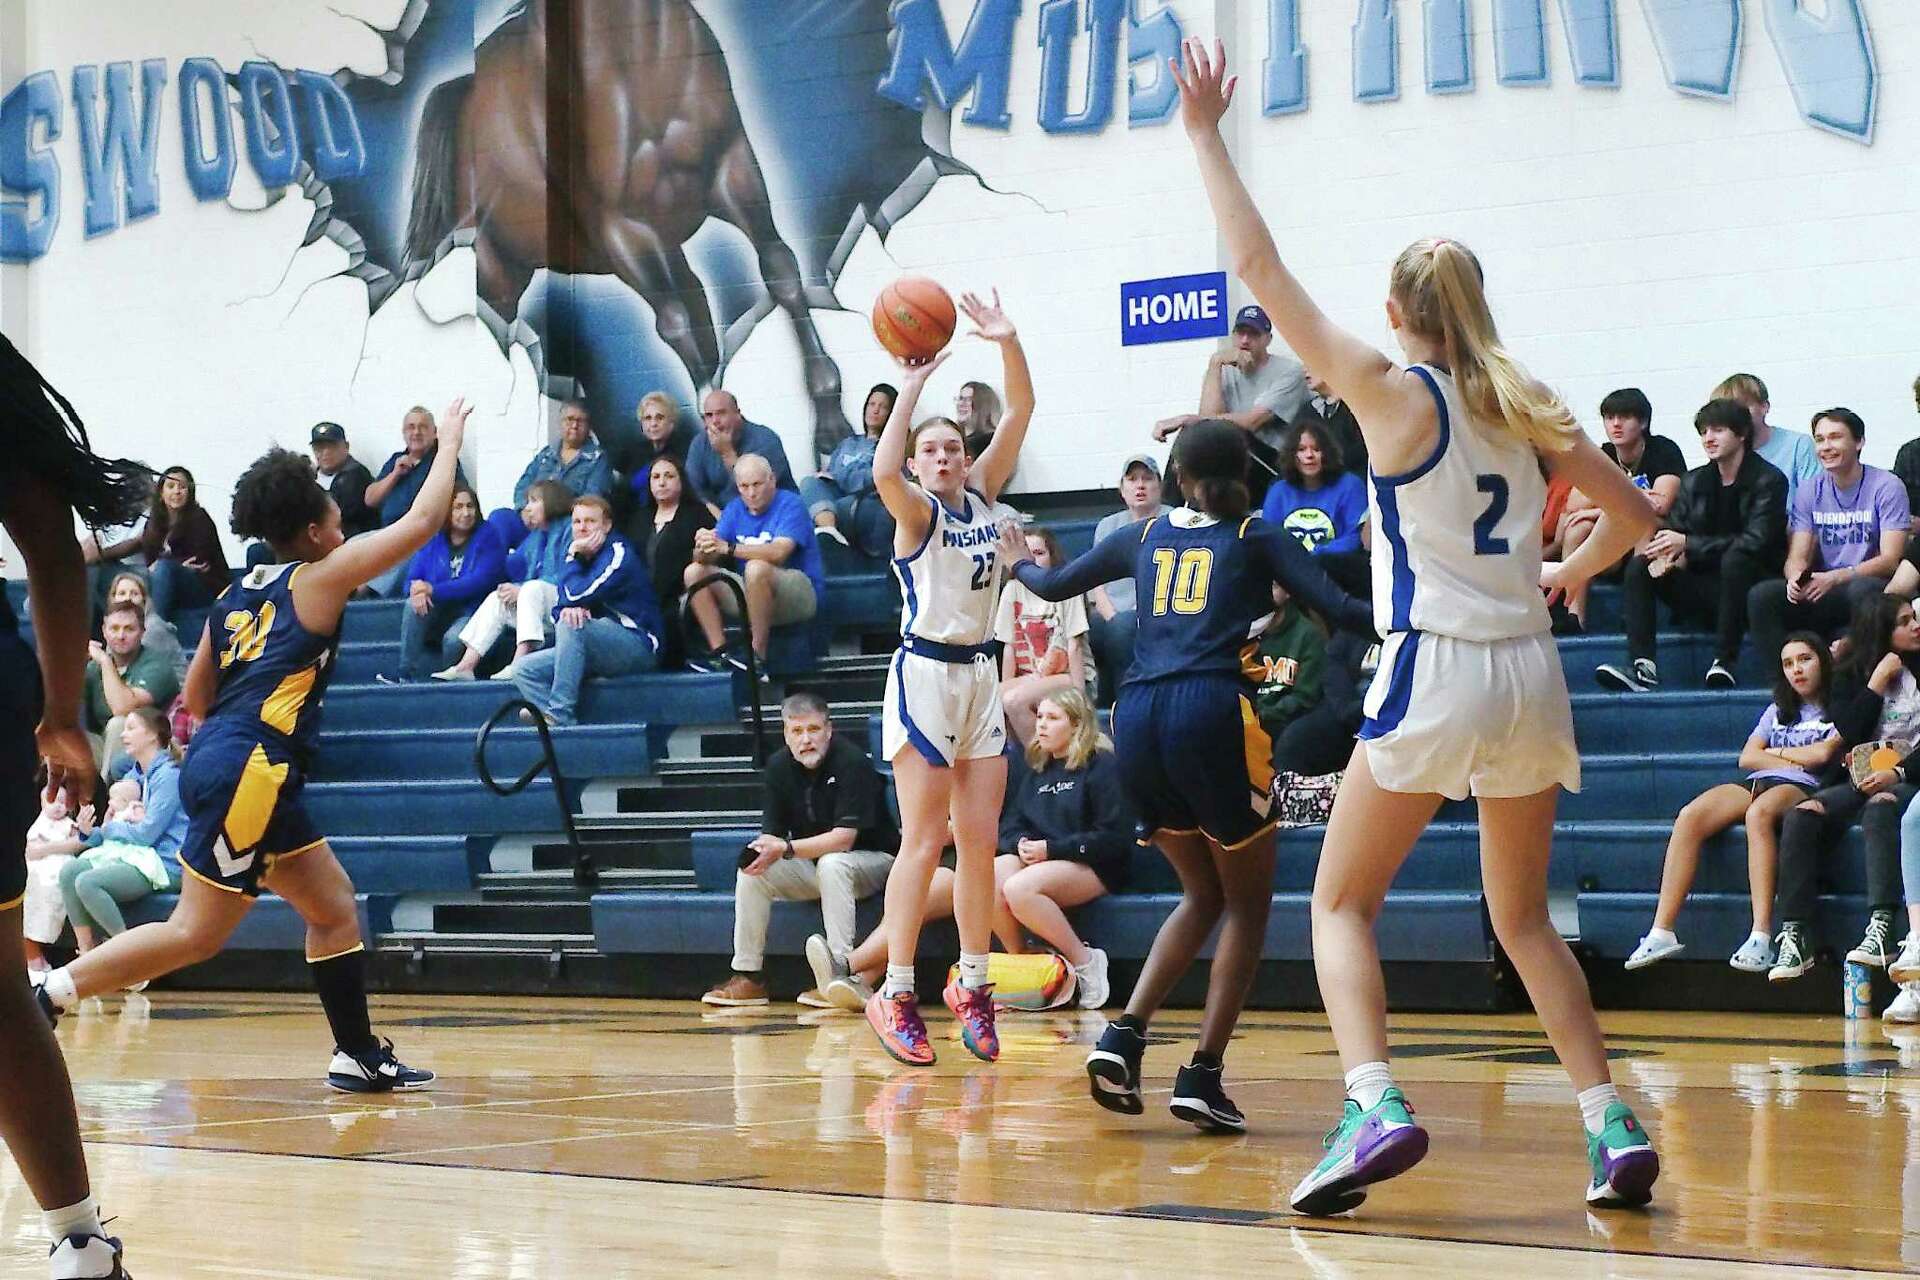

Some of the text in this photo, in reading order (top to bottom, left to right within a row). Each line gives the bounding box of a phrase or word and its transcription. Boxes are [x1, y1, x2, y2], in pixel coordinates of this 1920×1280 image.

[1128, 290, 1218, 327] HOME
[942, 522, 1001, 548] MUSTAN
[1473, 473, 1510, 555] 2
[1152, 547, 1214, 616] 10
